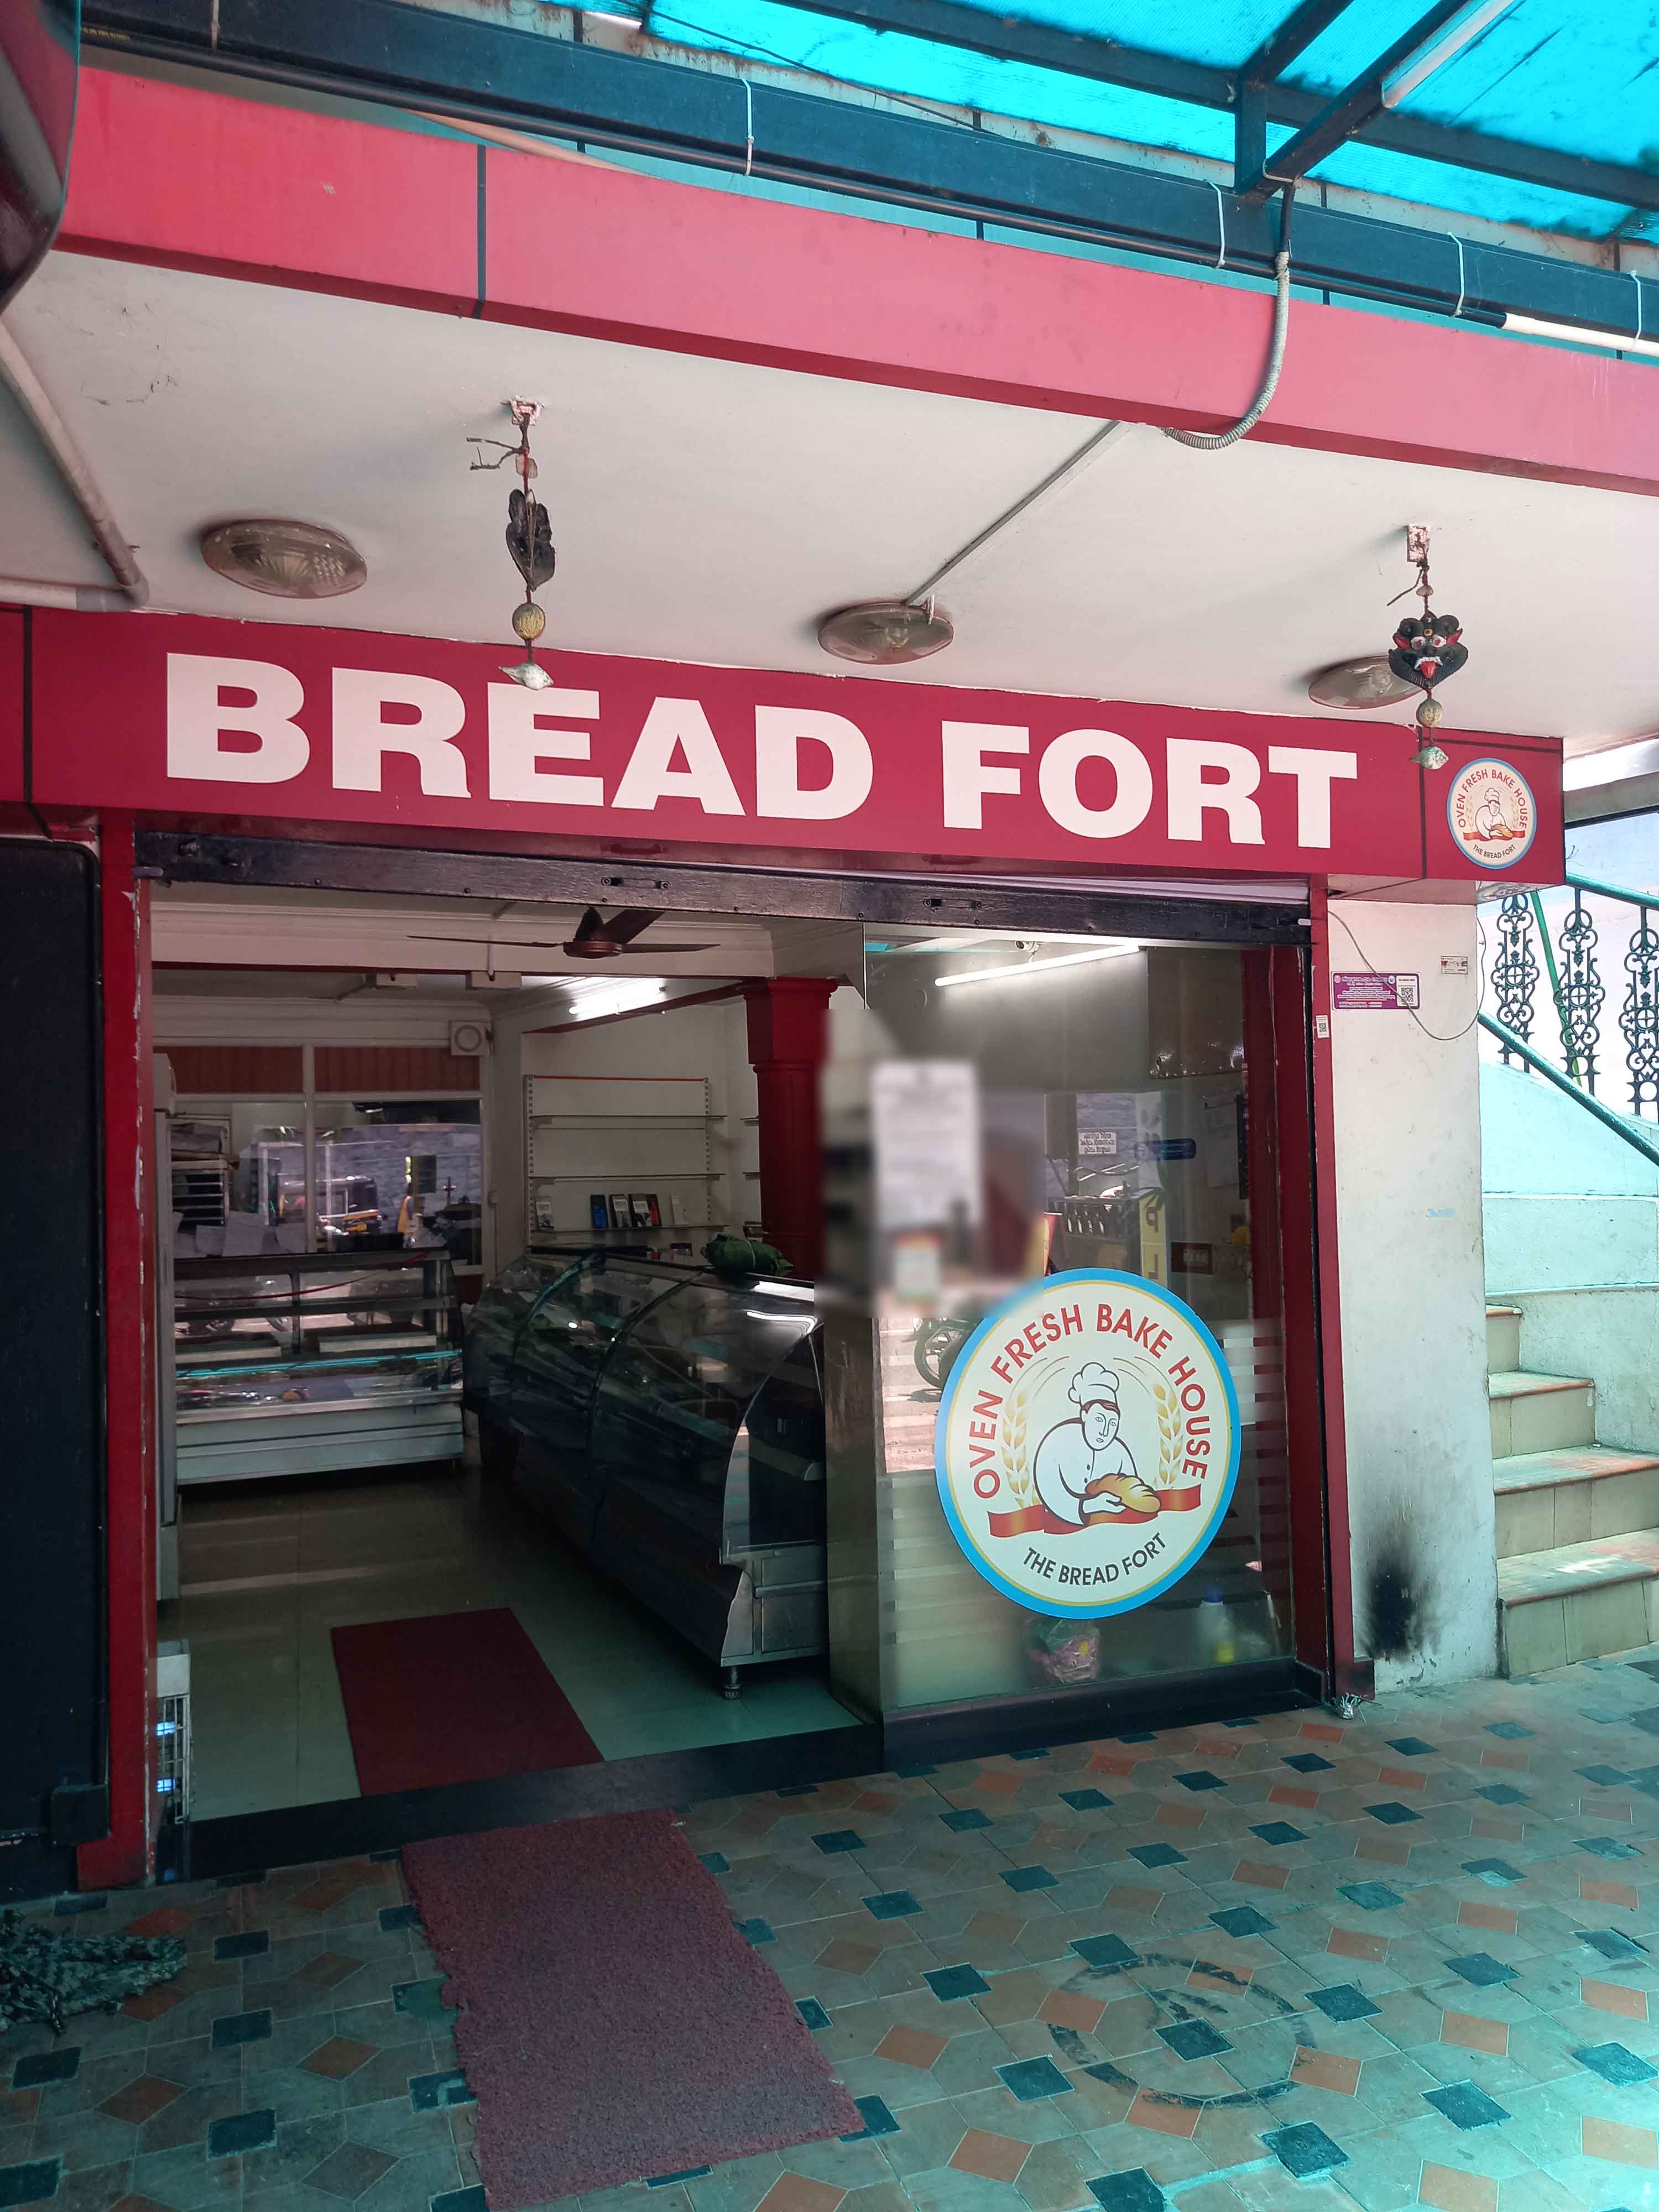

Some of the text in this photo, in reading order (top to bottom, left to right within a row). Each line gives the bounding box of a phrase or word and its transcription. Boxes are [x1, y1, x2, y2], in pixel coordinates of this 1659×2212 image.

[166, 653, 1358, 849] BREAD FORT
[1456, 769, 1527, 828] OVEN FRESH BAKE HOUSE
[1473, 844, 1483, 855] THE
[1503, 844, 1516, 857] FORT
[969, 1303, 1211, 1499] OVEN FRESH BAKE HOUSE
[1022, 1532, 1166, 1585] THE BREAD FORT
